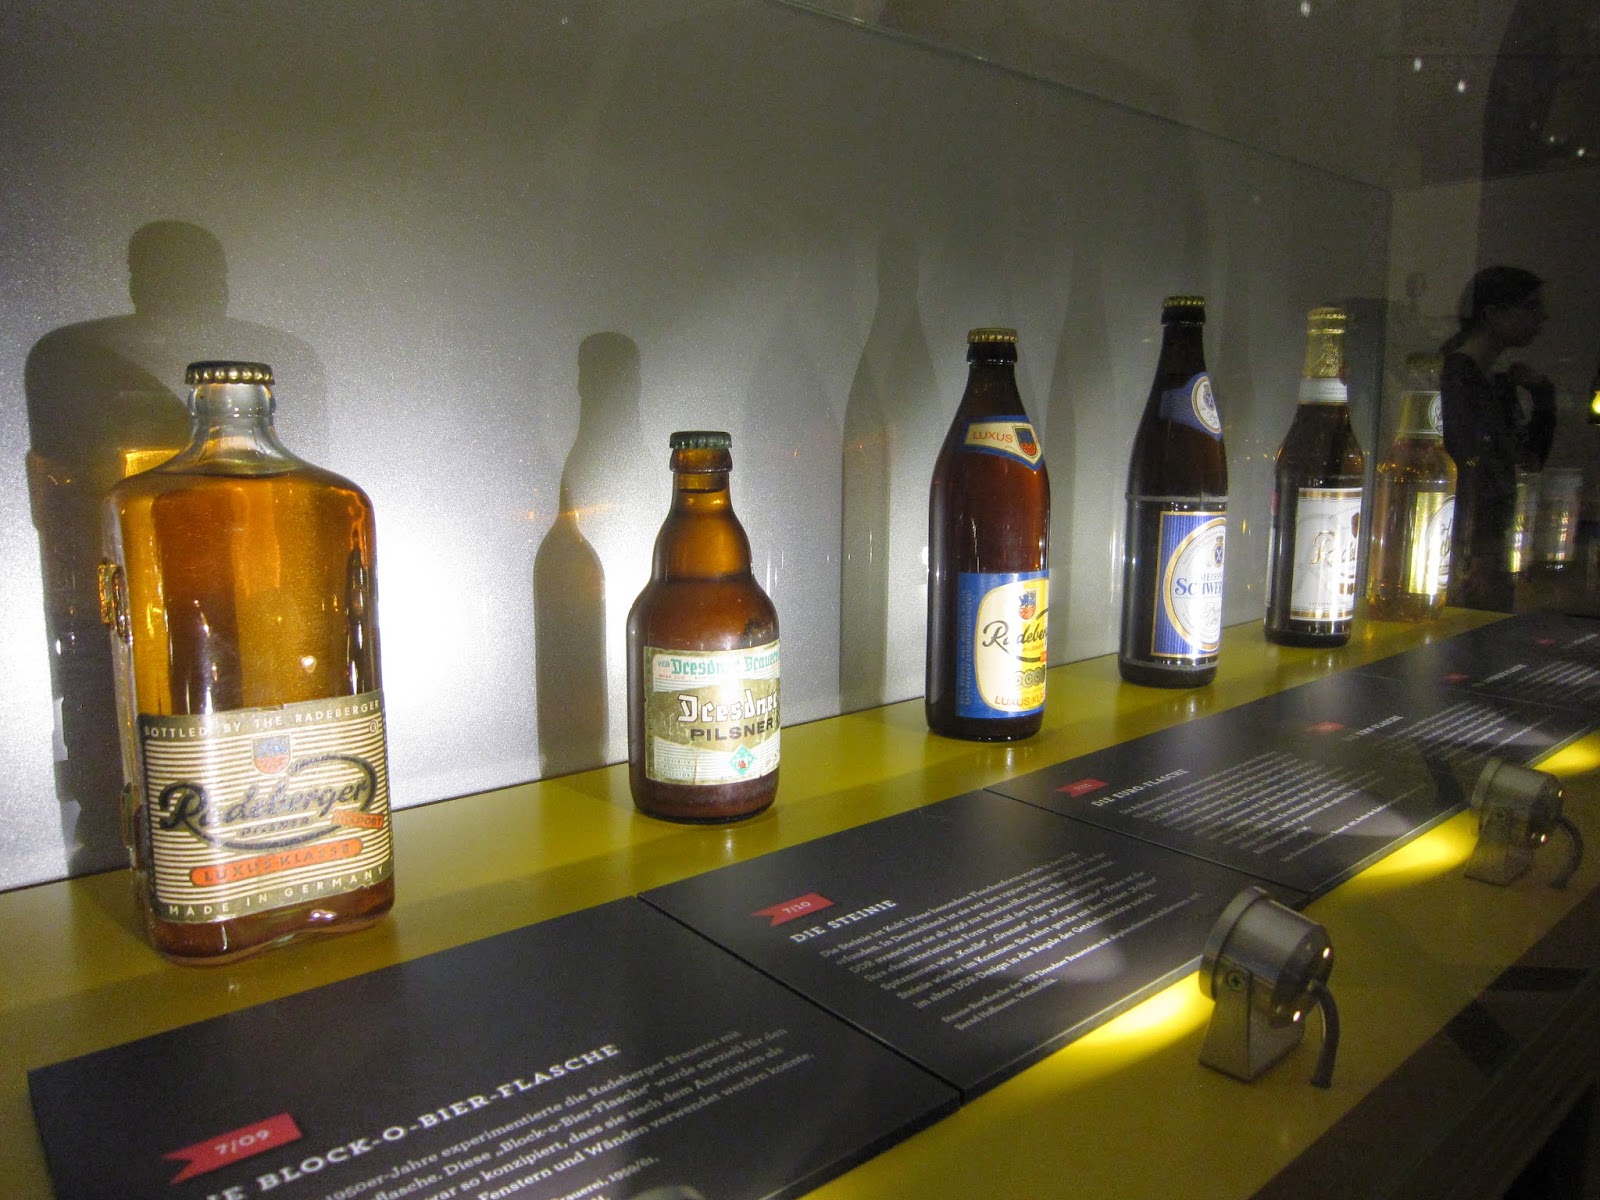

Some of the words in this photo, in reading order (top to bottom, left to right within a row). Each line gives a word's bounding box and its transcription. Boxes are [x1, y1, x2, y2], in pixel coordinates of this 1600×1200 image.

[972, 431, 1013, 443] LUXUS
[145, 725, 208, 738] BOTTLED
[223, 722, 241, 733] BY
[255, 715, 282, 728] THE
[295, 699, 381, 723] RADEBERGER
[677, 690, 778, 722] Dresdner
[690, 718, 773, 741] PILSNER
[242, 816, 310, 837] PILSNER
[169, 902, 230, 915] MADE
[246, 892, 268, 907] IN
[284, 866, 384, 897] GERMANY
[782, 902, 810, 913] 7/10
[790, 927, 825, 942] DIE
[827, 899, 898, 929] STEINIE
[257, 1044, 622, 1191] BLOCK-O-BIER-FLASCHE
[442, 1105, 561, 1156] experimentierte
[565, 1094, 587, 1106] die
[589, 1062, 664, 1096] Radeberger
[216, 1130, 269, 1154] 7/09
[461, 1178, 480, 1190] so
[481, 1143, 567, 1180] konzipiert,
[569, 1125, 603, 1143] dass
[605, 1116, 625, 1128] sie
[444, 1153, 491, 1175] Diese
[478, 1169, 551, 1200] Fenstern
[554, 1152, 585, 1171] und
[585, 1126, 649, 1155] Wänden
